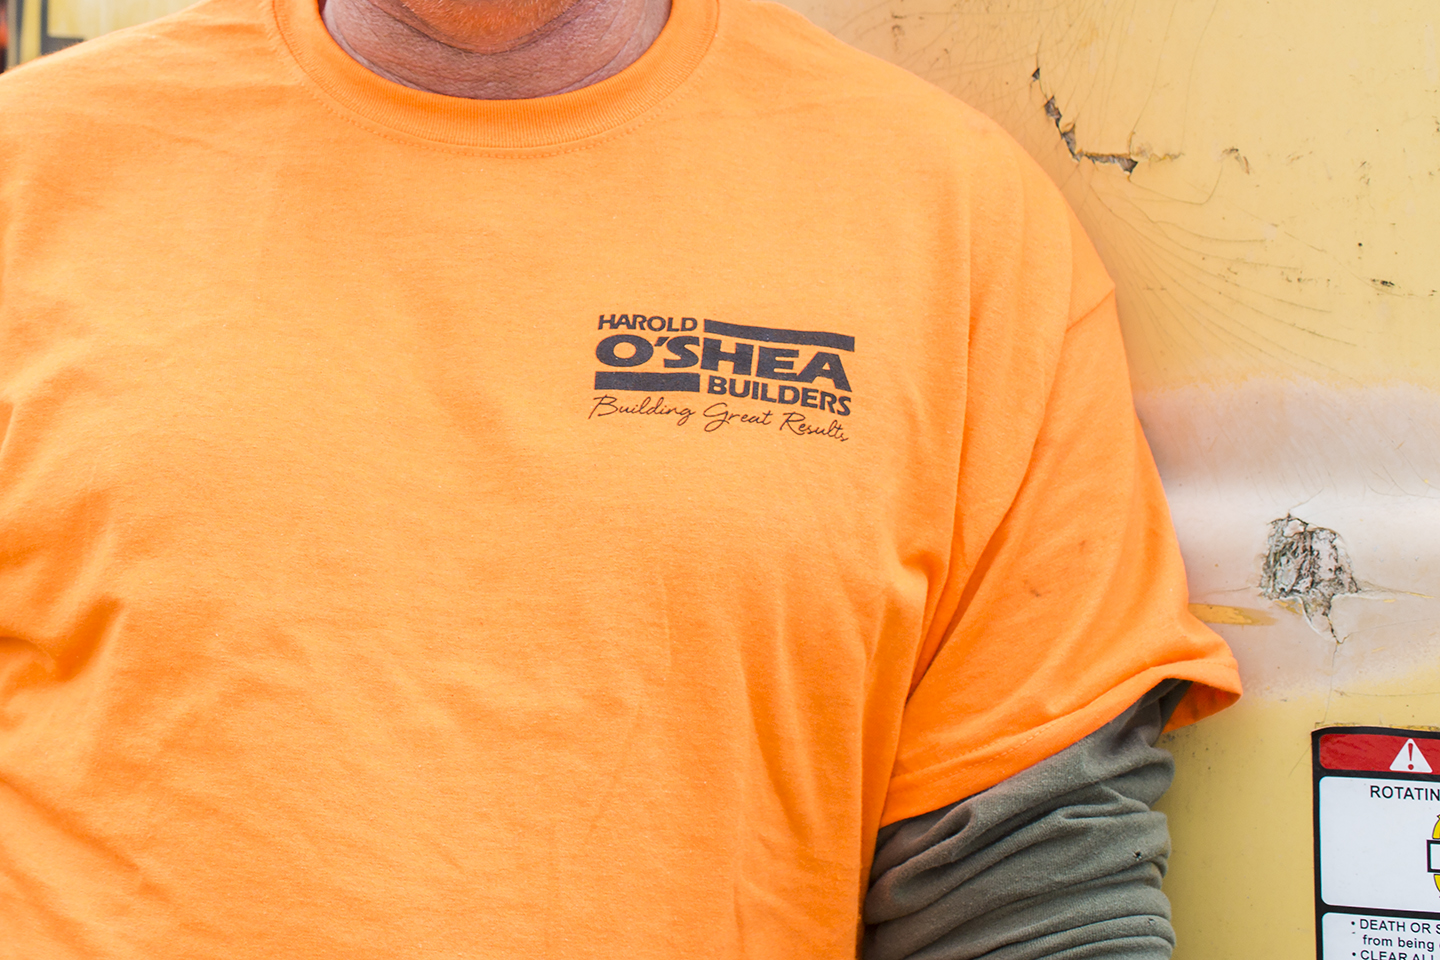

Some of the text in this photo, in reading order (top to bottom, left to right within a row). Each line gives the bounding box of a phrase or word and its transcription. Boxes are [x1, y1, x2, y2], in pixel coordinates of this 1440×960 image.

[597, 313, 698, 332] HAROLD
[595, 334, 853, 393] O'SHEA
[707, 375, 852, 416] BUILDERS
[588, 394, 850, 442] Building Great Results
[1359, 918, 1406, 933] DEATH
[1410, 922, 1432, 935] OR
[1362, 934, 1435, 952] from being
[1360, 949, 1408, 960] CLEAR
